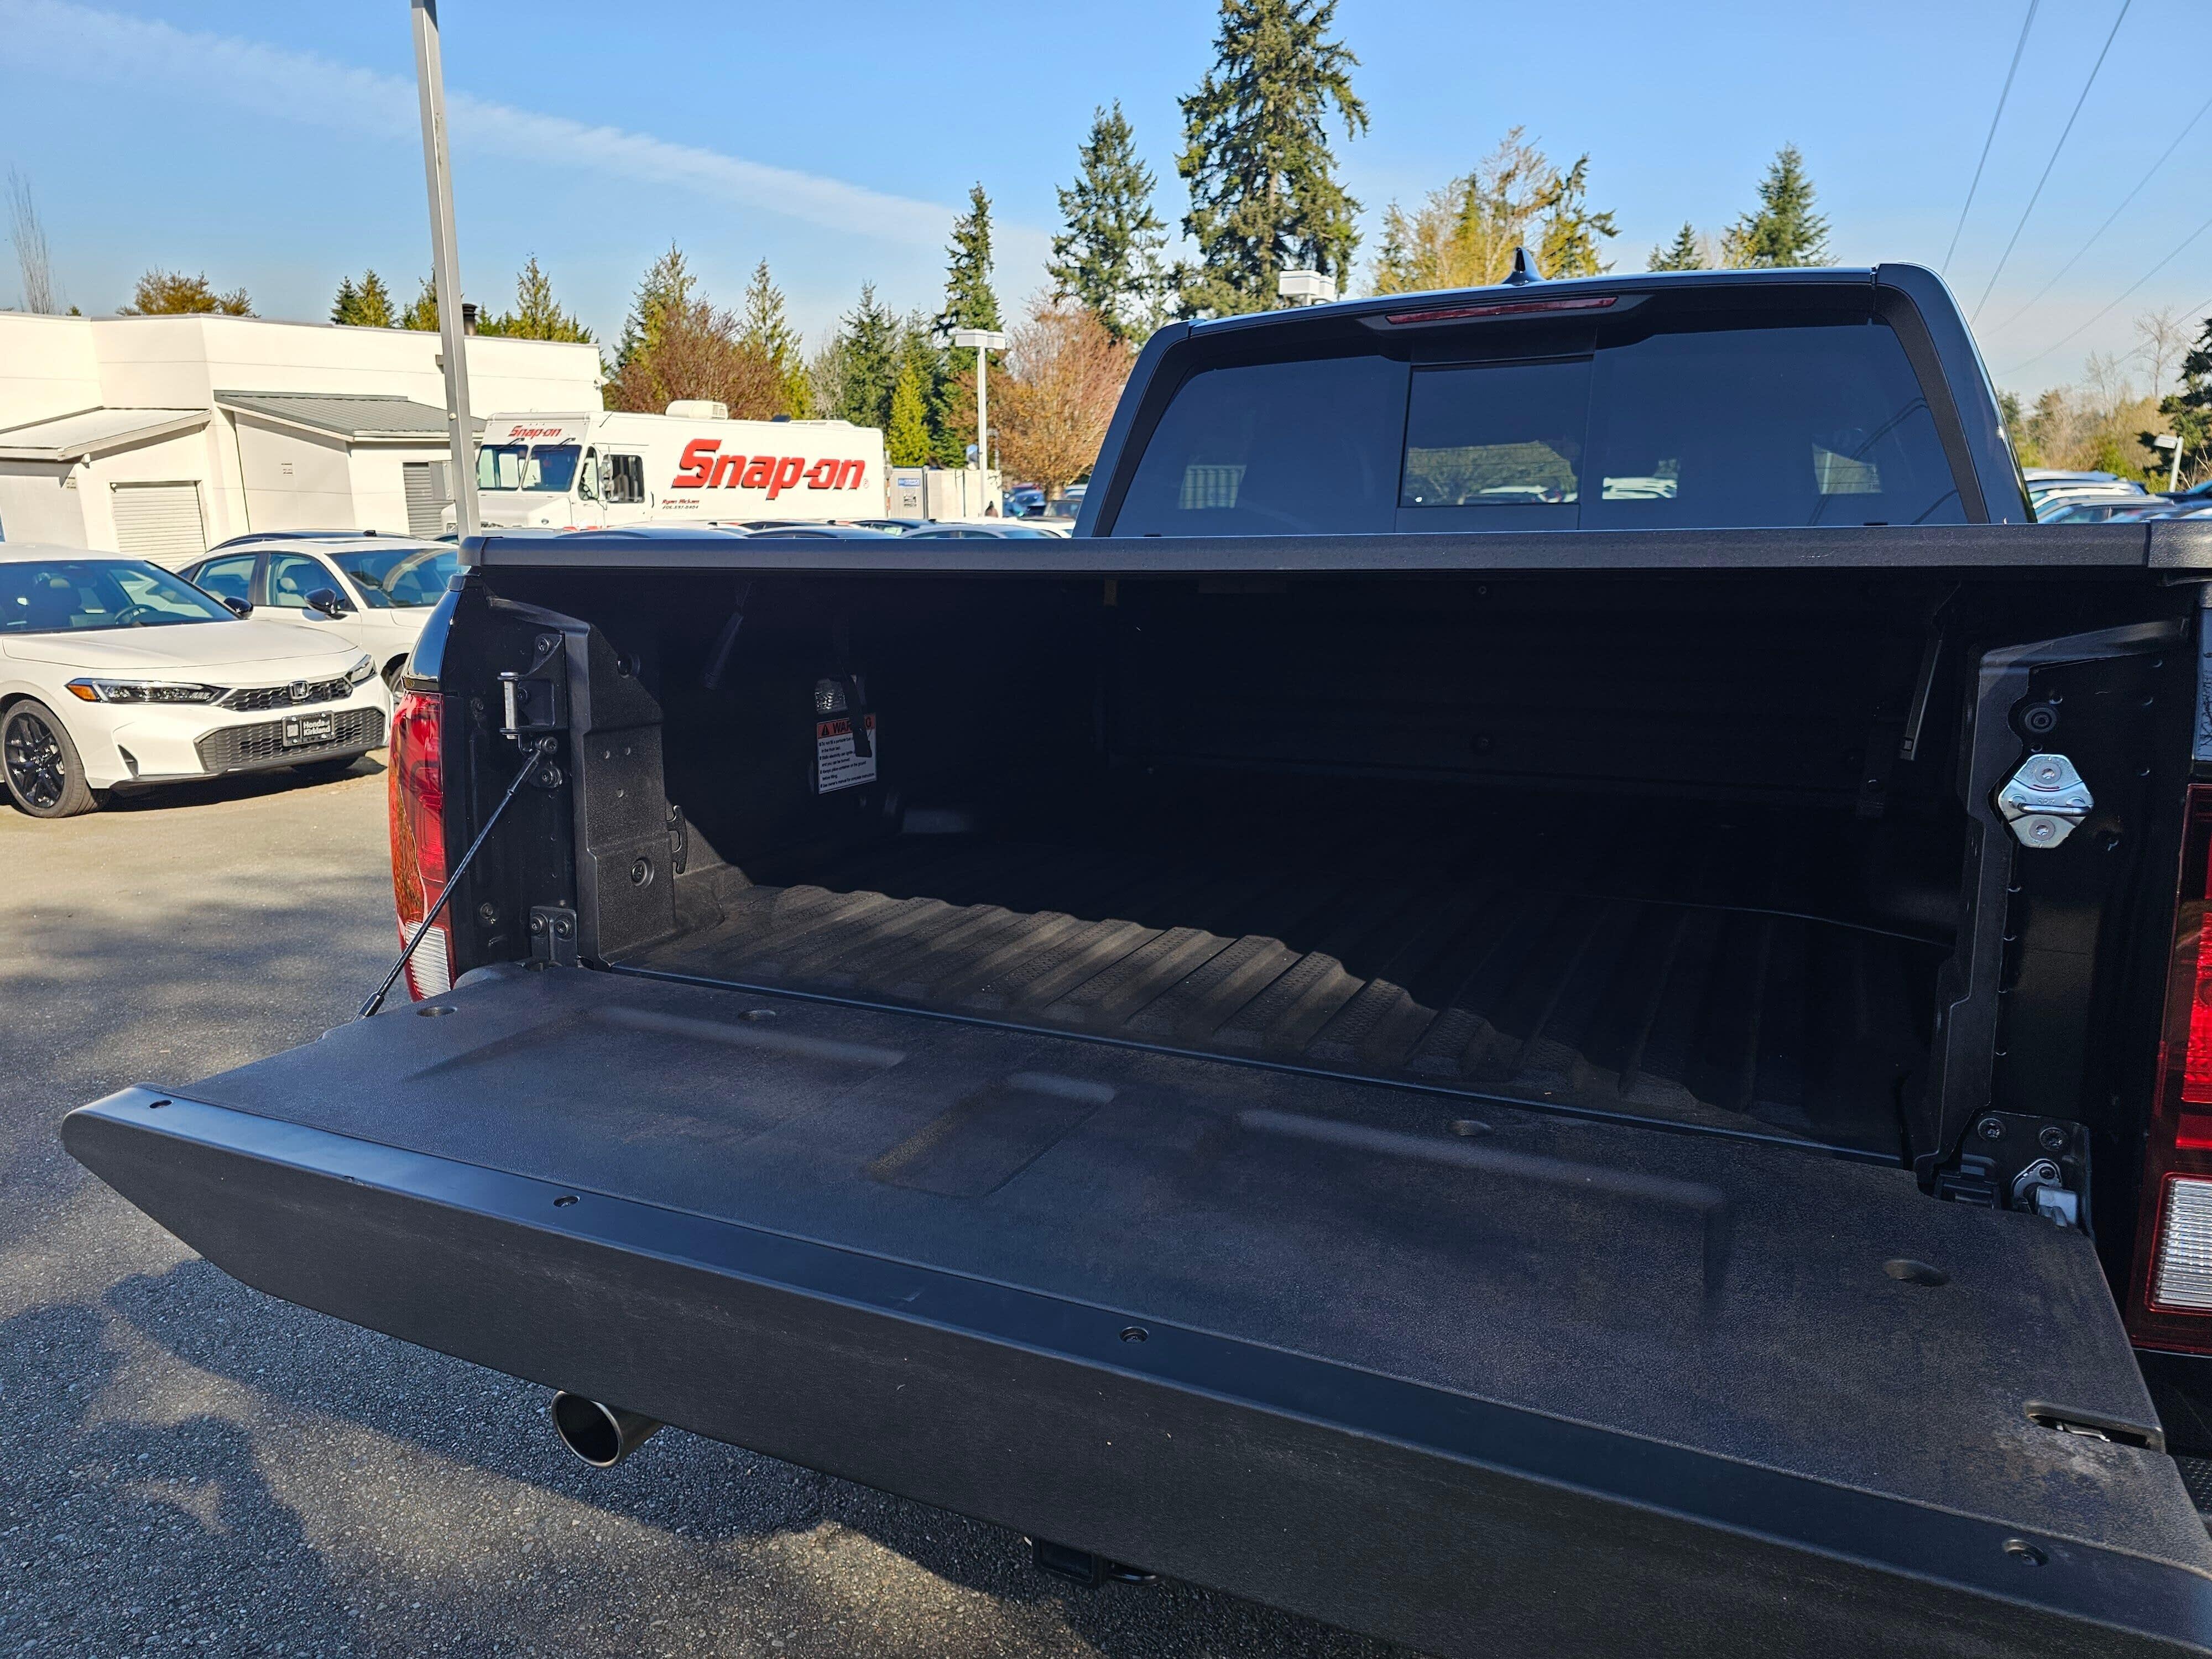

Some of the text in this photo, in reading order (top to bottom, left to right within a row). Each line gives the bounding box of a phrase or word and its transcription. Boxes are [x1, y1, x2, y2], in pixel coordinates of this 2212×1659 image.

[508, 425, 562, 440] Snap-on
[671, 439, 866, 500] Snap-on
[303, 719, 325, 729] Honda
[303, 725, 331, 736] Kirkland
